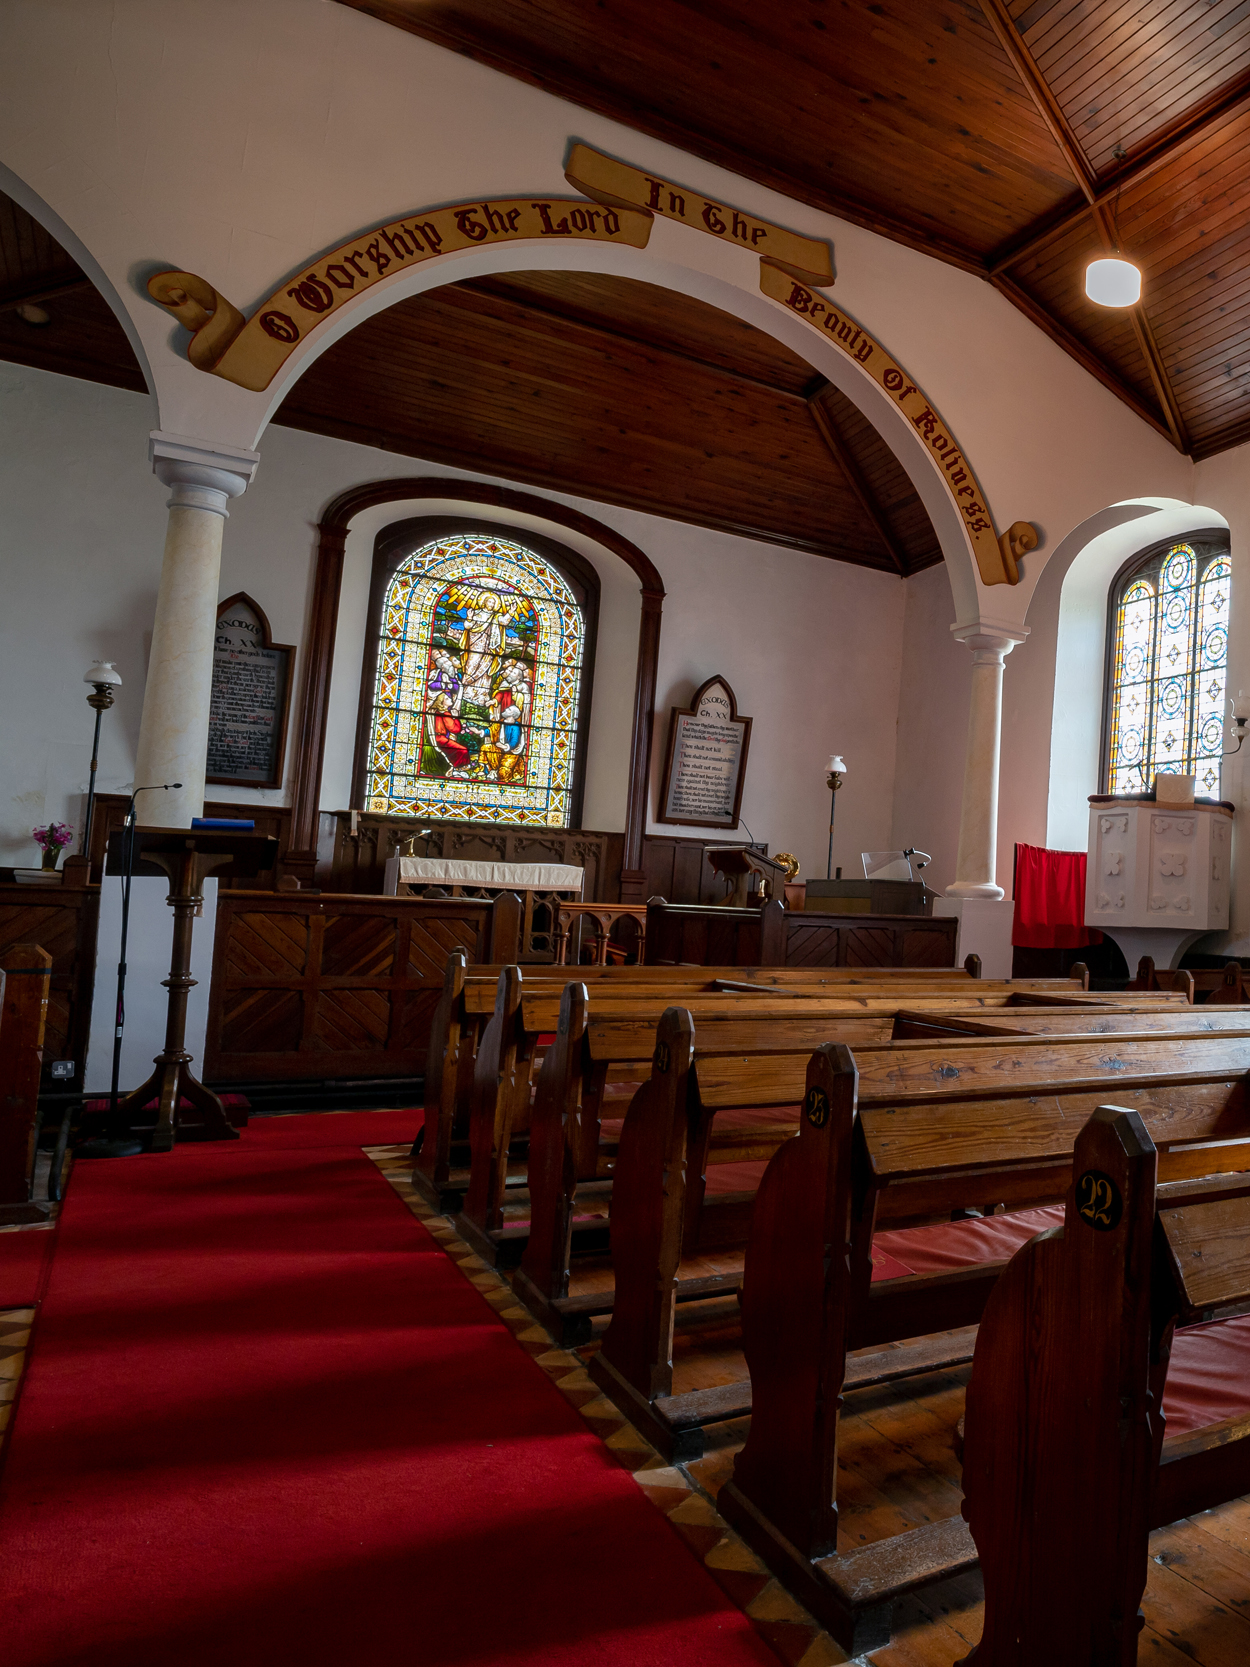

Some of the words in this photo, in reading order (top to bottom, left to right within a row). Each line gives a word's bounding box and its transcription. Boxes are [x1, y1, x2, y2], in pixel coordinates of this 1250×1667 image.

[643, 176, 688, 217] In
[700, 201, 768, 246] The
[259, 309, 301, 343] O
[286, 219, 444, 314] Worship
[452, 203, 521, 241] The
[530, 202, 622, 236] Lord
[784, 280, 874, 364] Beauty
[882, 367, 918, 401] Of
[216, 636, 235, 646] Ch.
[240, 638, 258, 649] XX
[700, 696, 730, 709] EXODUS
[700, 710, 713, 718] Ch.
[715, 712, 728, 720] XX
[808, 1090, 825, 1125] 23
[1080, 1175, 1113, 1225] 22
